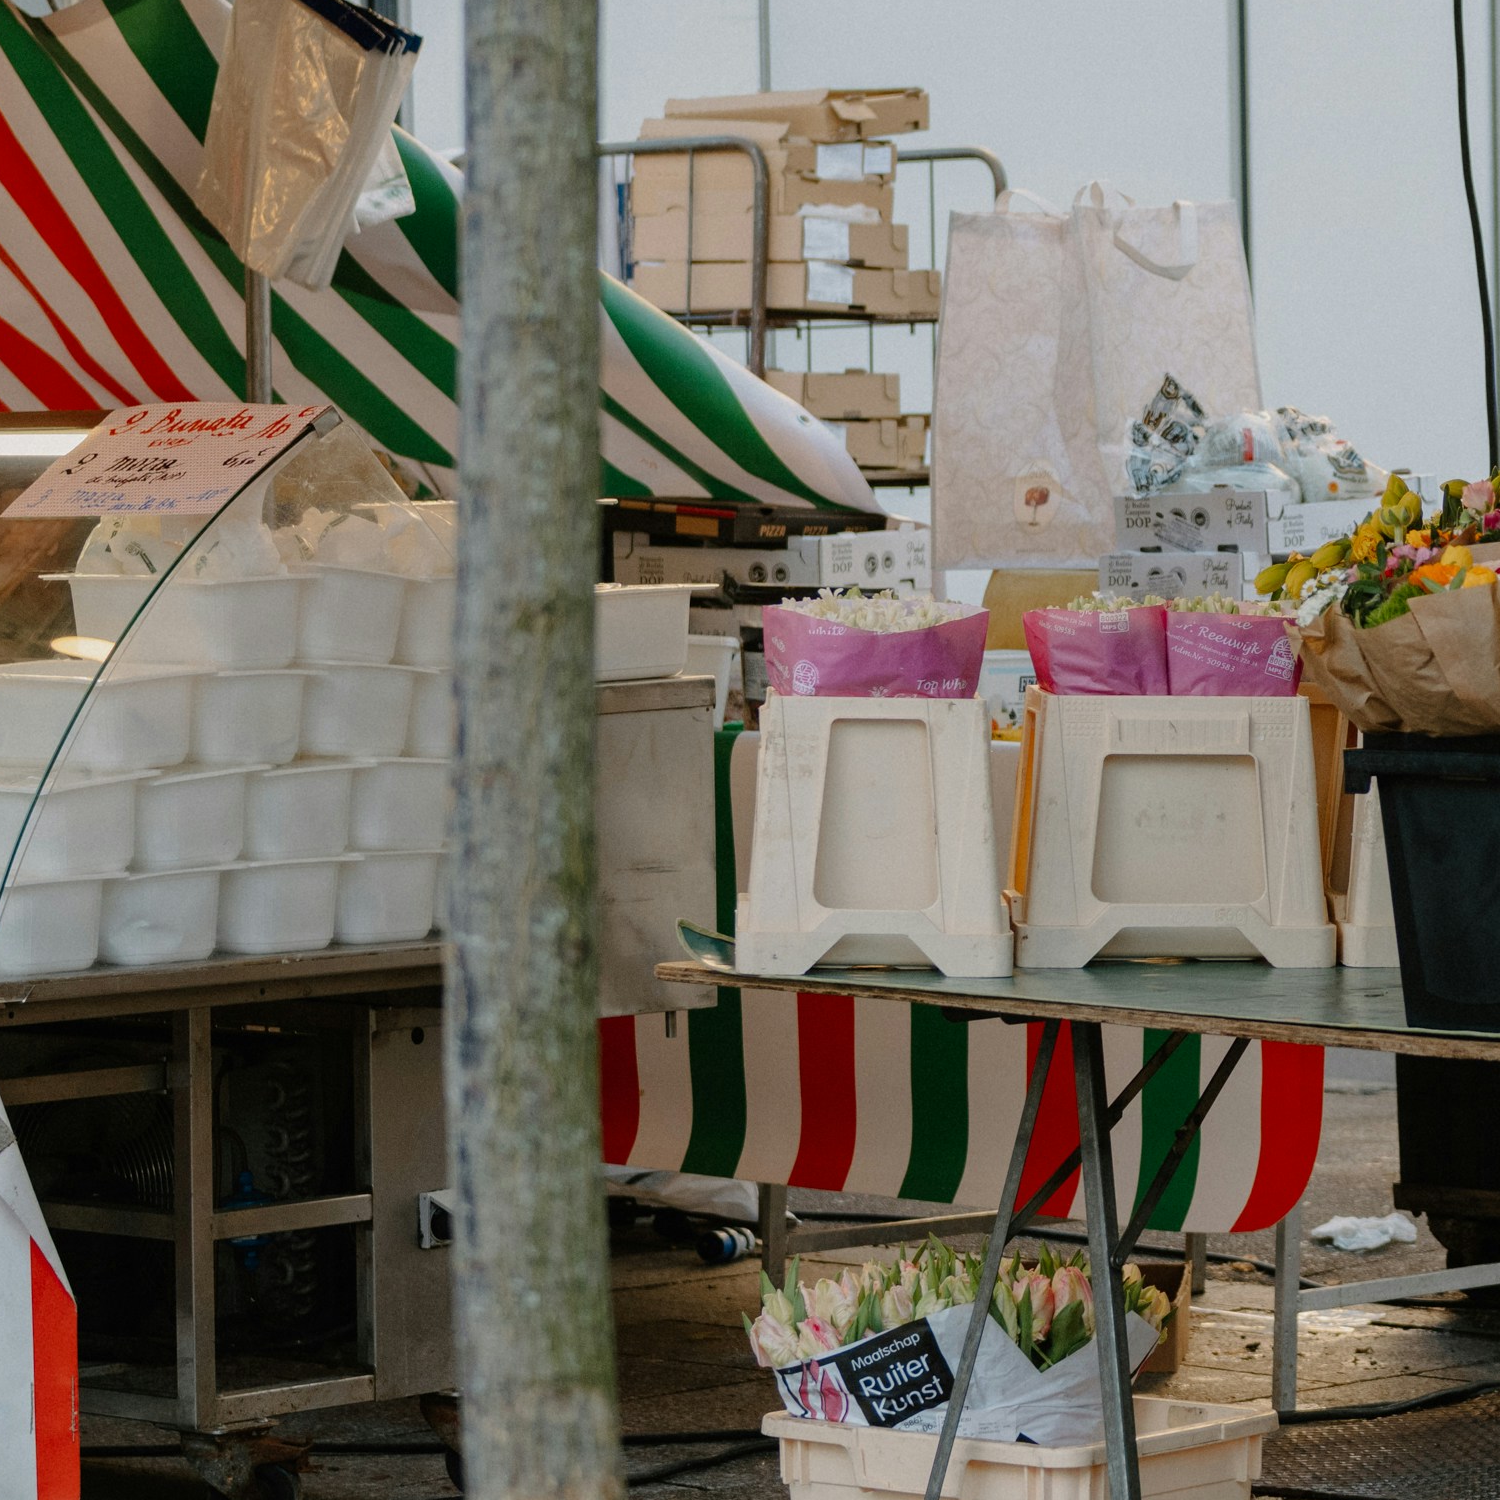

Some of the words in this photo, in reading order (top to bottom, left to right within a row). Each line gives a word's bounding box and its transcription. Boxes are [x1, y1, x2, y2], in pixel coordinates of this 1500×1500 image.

[1225, 499, 1253, 513] Product
[1126, 517, 1151, 529] DOP
[759, 524, 787, 538] PIZZA
[803, 524, 829, 537] PIZZA
[1284, 535, 1305, 548] DOP
[832, 561, 853, 574] DOP
[1203, 560, 1229, 573] Product
[639, 575, 665, 584] DOP
[1108, 575, 1132, 587] DOP
[1053, 624, 1076, 637] 509583
[1101, 623, 1118, 632] MPS
[1197, 625, 1263, 657] Reeuwijk
[1206, 656, 1236, 673] 509583
[1267, 665, 1283, 677] MPS
[916, 679, 938, 693] Top
[850, 1332, 921, 1372] Maatschap
[858, 1353, 931, 1398] Ruiter
[871, 1374, 945, 1422] Kunst
